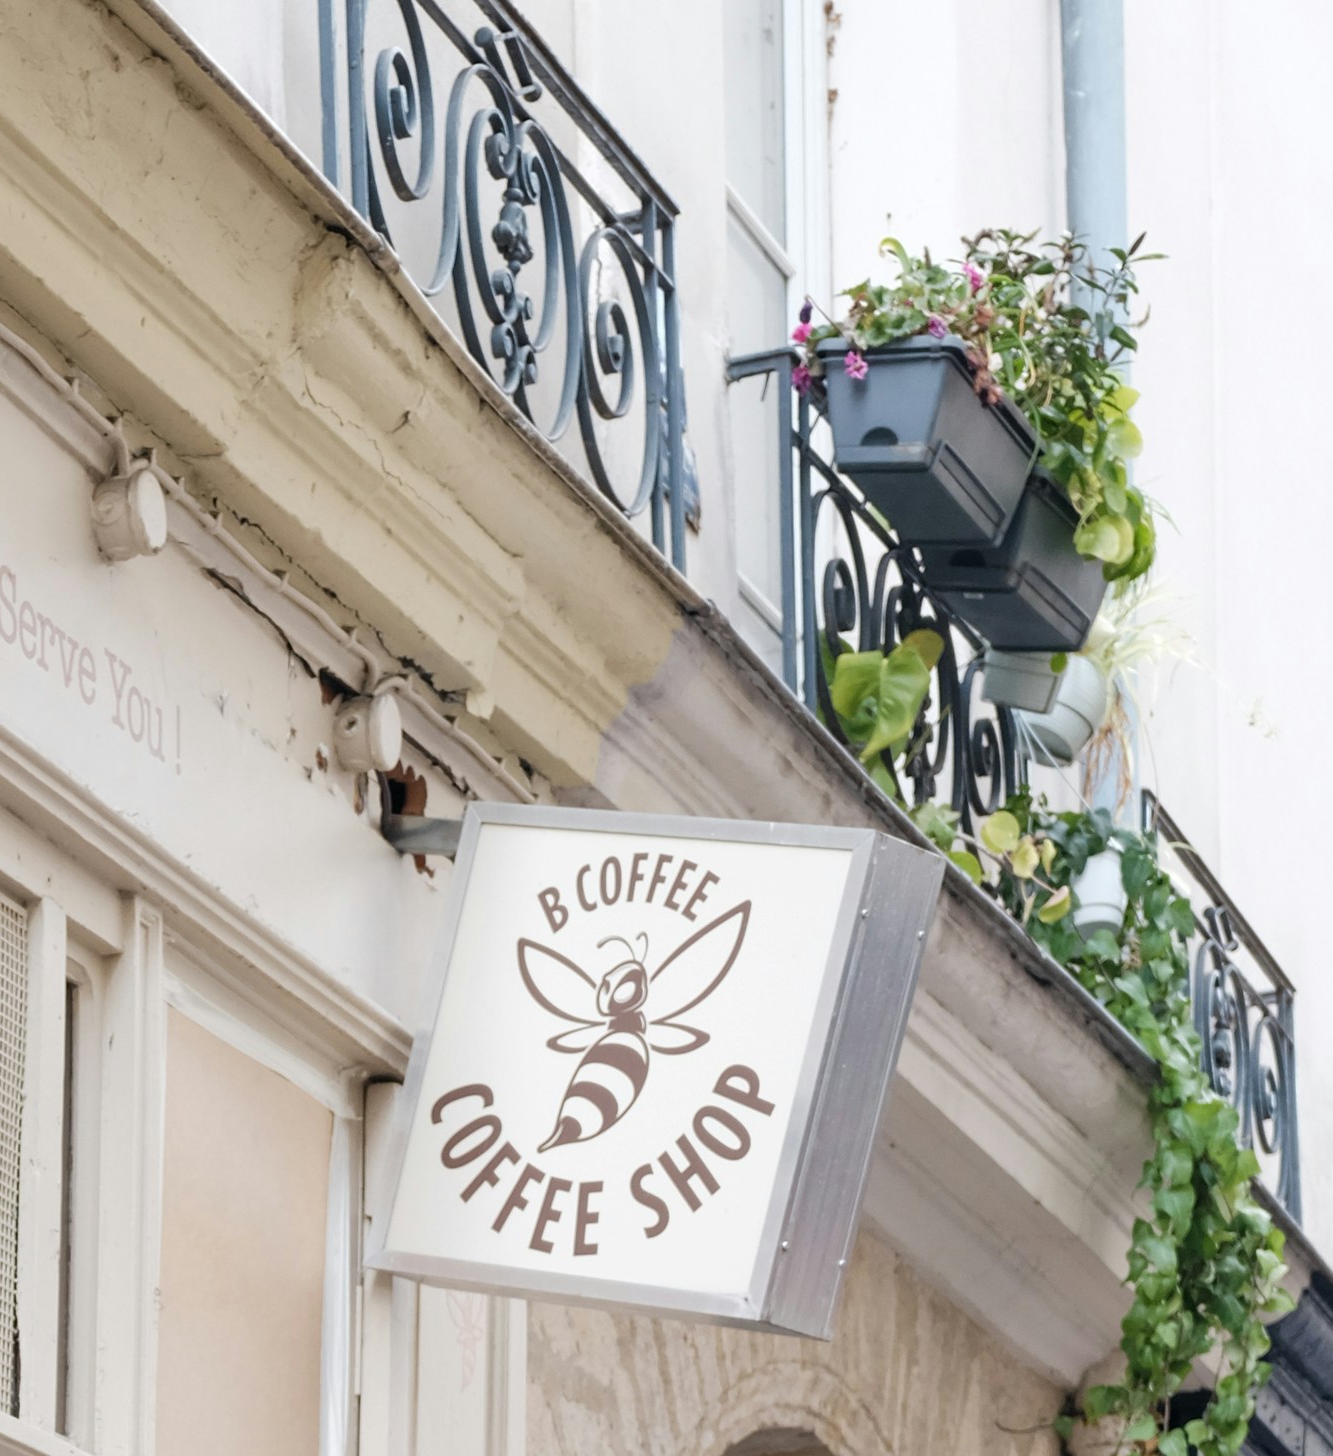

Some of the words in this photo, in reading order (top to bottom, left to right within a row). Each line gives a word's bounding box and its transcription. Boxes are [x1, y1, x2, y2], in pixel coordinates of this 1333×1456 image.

[536, 885, 570, 934] B
[575, 851, 721, 923] COFFEE
[430, 1082, 605, 1257] COFFEE
[629, 1062, 777, 1239] SHOP
